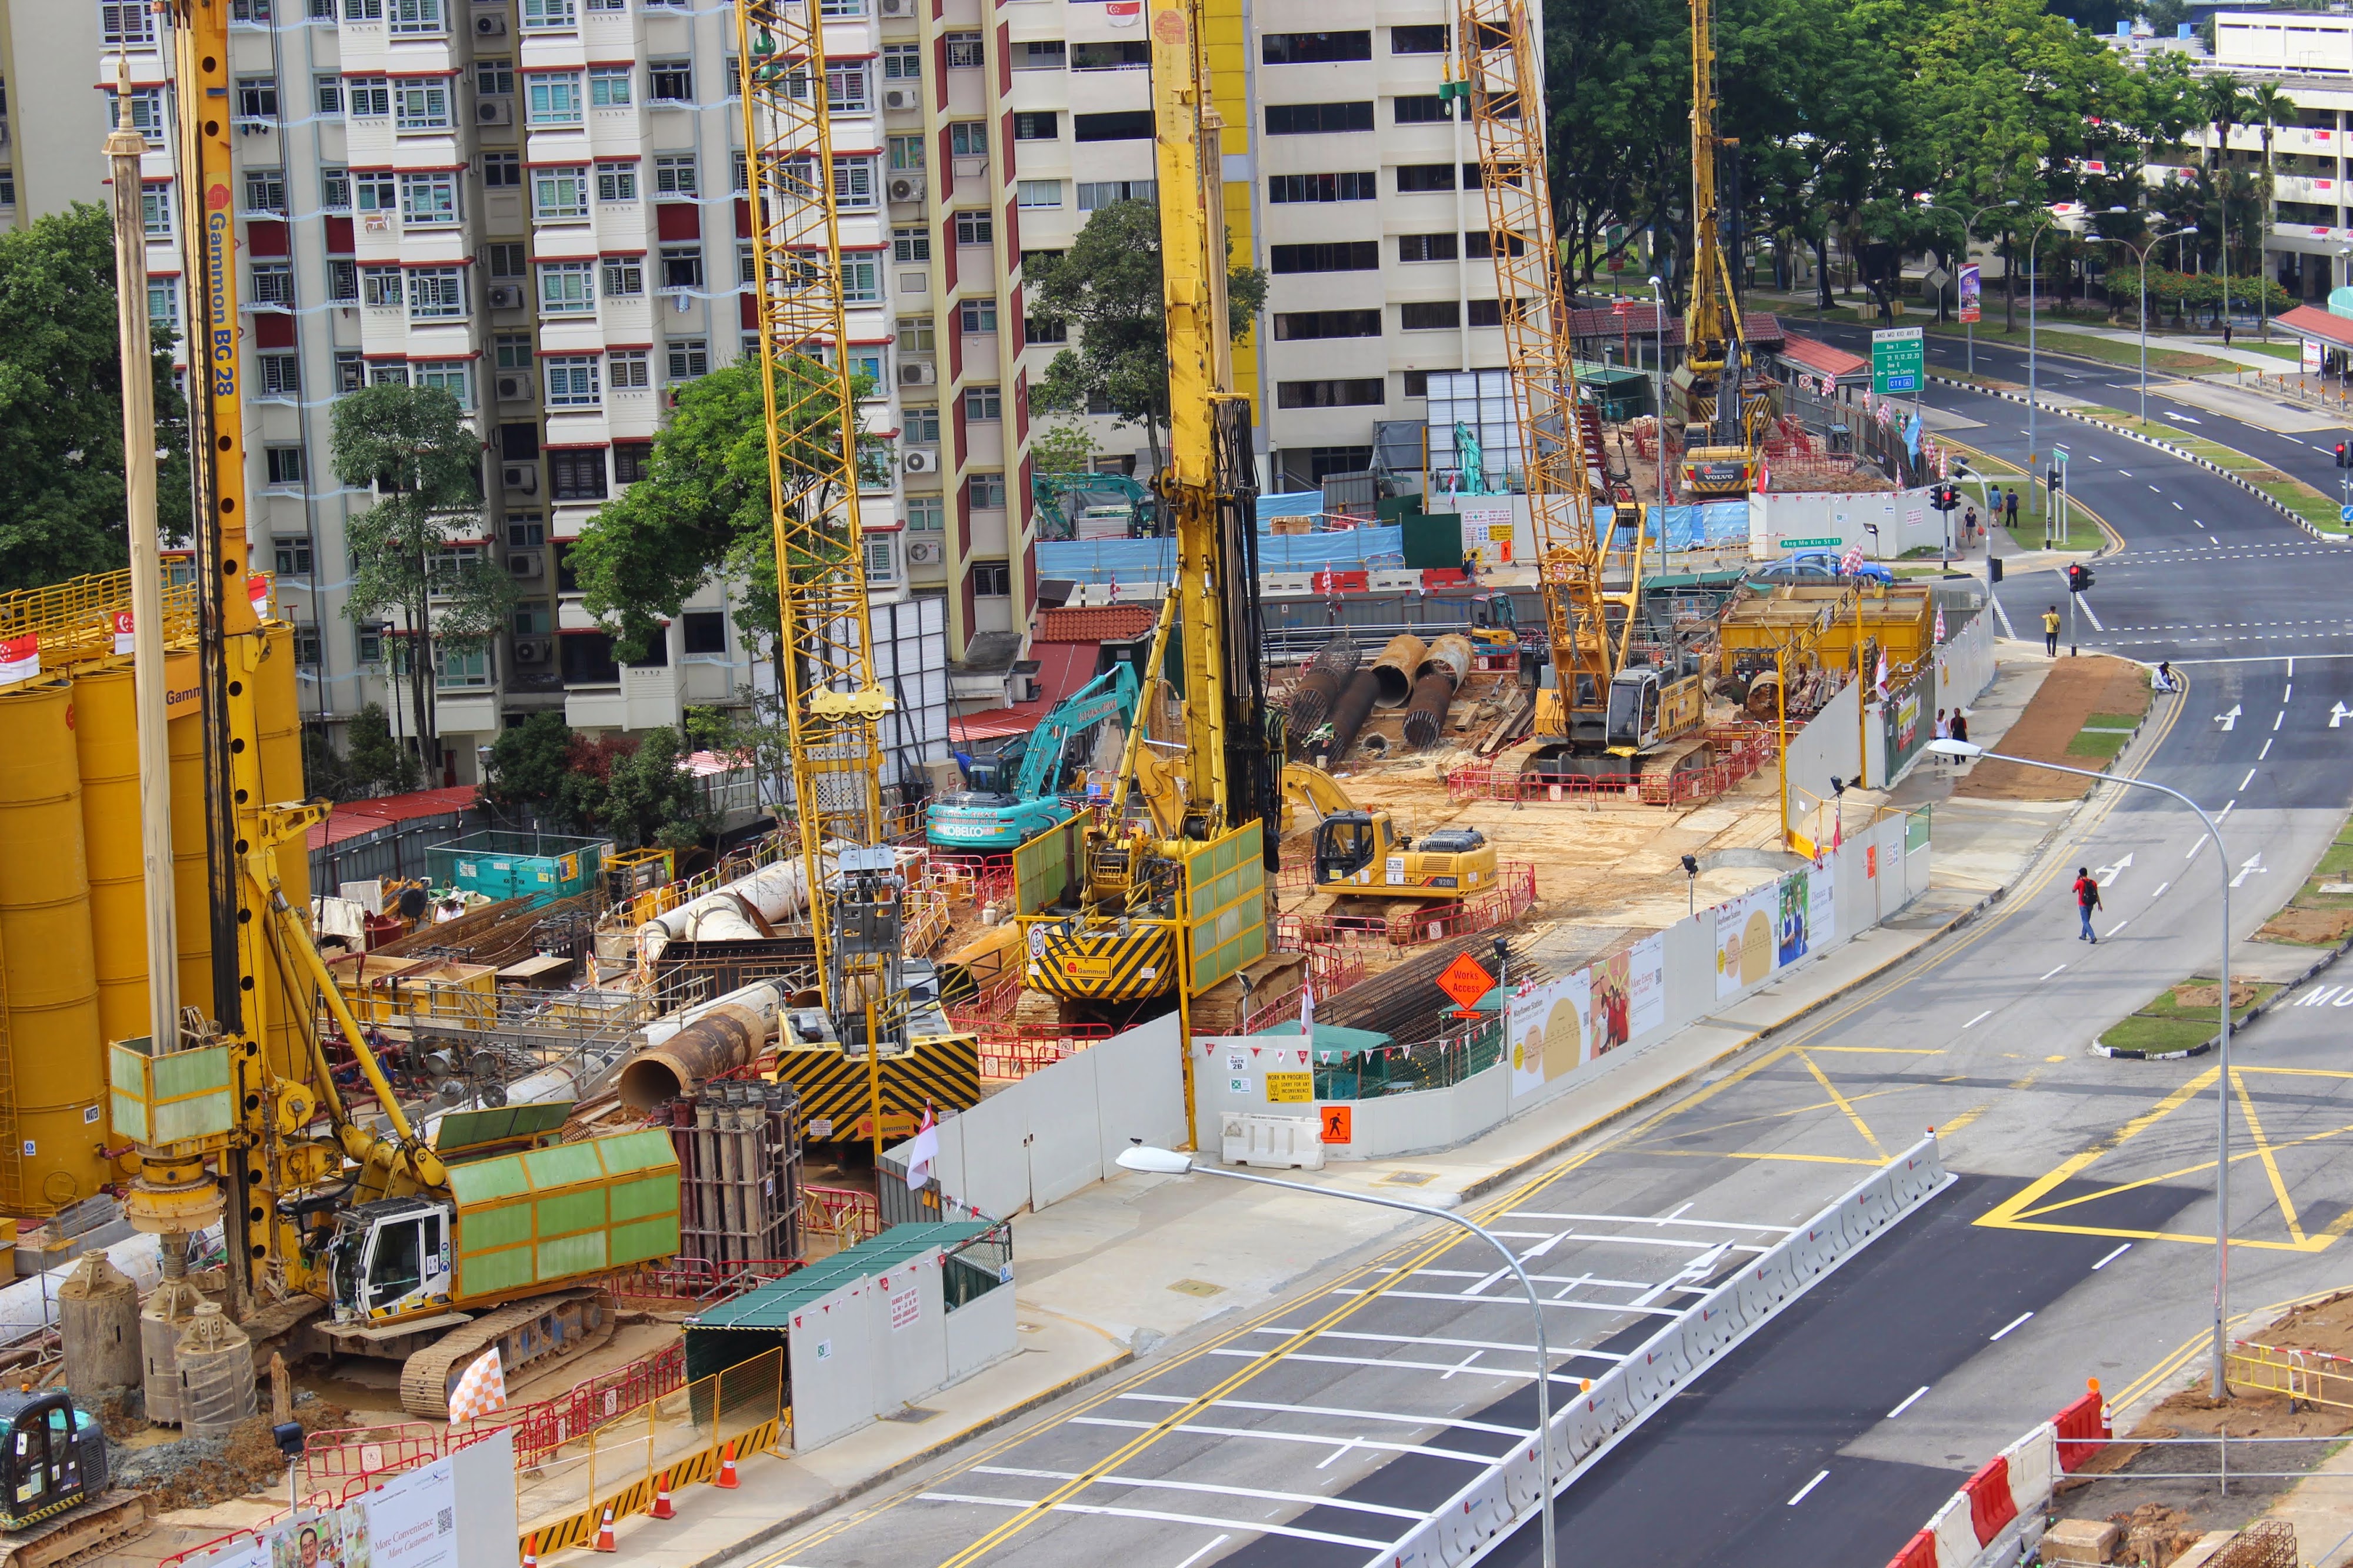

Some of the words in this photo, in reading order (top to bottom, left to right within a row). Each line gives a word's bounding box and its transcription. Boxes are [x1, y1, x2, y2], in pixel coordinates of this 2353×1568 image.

[209, 212, 226, 324] Gammon
[214, 329, 232, 361] BG
[216, 367, 234, 396] 28
[166, 687, 201, 706] Gamm
[943, 825, 984, 838] KOBELCO
[1718, 915, 1731, 926] Mayflower
[1731, 910, 1741, 919] Station
[1454, 970, 1479, 980] Works
[1631, 978, 1641, 989] More
[1642, 971, 1654, 984] Energy
[1453, 983, 1479, 993] Access
[1514, 1005, 1531, 1018] Mayflower
[1531, 999, 1543, 1010] Station
[85, 1107, 99, 1122] WATER
[881, 1124, 910, 1133] ammon
[375, 1538, 391, 1552] More
[393, 1518, 434, 1543] Convenience
[388, 1547, 403, 1560] More
[404, 1532, 434, 1551] Customers
